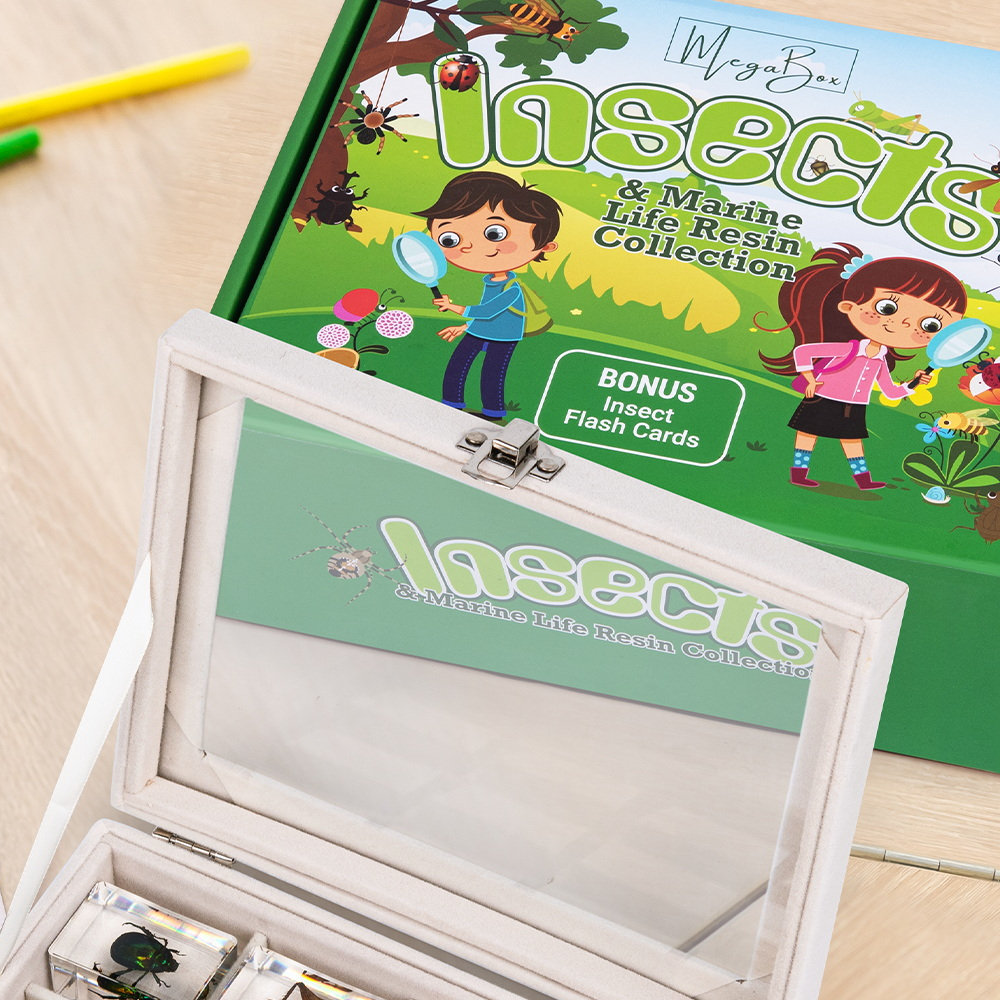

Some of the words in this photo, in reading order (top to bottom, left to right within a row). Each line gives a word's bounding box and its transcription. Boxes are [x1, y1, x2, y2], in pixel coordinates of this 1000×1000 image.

[680, 25, 841, 93] MegaBox
[430, 51, 1000, 257] Insects
[601, 200, 679, 234] Life
[688, 215, 800, 256] Resin
[618, 179, 649, 203] &
[658, 185, 803, 230] Marine
[594, 225, 796, 282] Collection
[598, 367, 697, 403] BONUS
[603, 396, 675, 423] Insect
[563, 409, 626, 435] Flash
[633, 422, 700, 448] Cards
[377, 516, 822, 667] Insects
[395, 583, 418, 601] &
[424, 588, 527, 623] Marine
[533, 611, 588, 636] Life
[594, 624, 675, 654] Resin
[682, 642, 814, 680] Collectio
